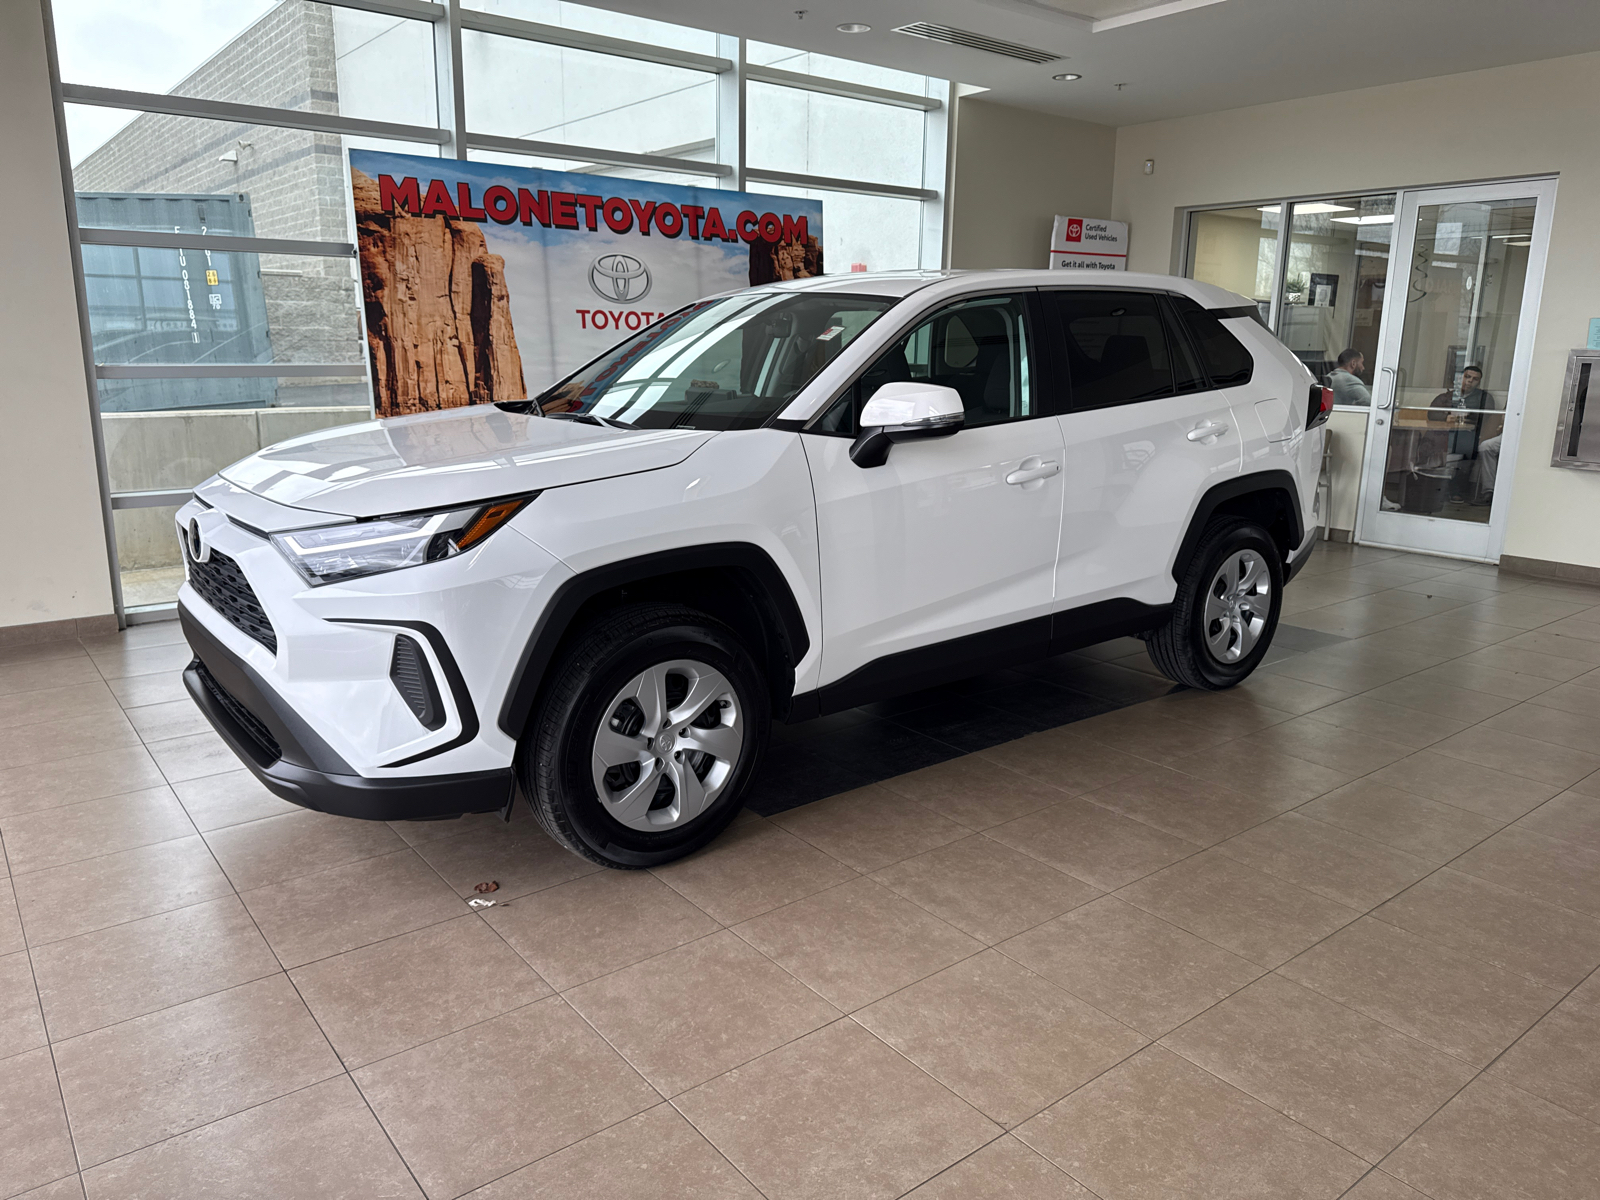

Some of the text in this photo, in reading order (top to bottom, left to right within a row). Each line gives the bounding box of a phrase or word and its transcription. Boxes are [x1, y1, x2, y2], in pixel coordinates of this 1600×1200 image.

[378, 174, 808, 248] MALONETOYOTA.COM
[1085, 223, 1107, 233] Certified
[1085, 233, 1118, 243] Used Vehicles
[1061, 260, 1116, 271] Get it all with Toyota
